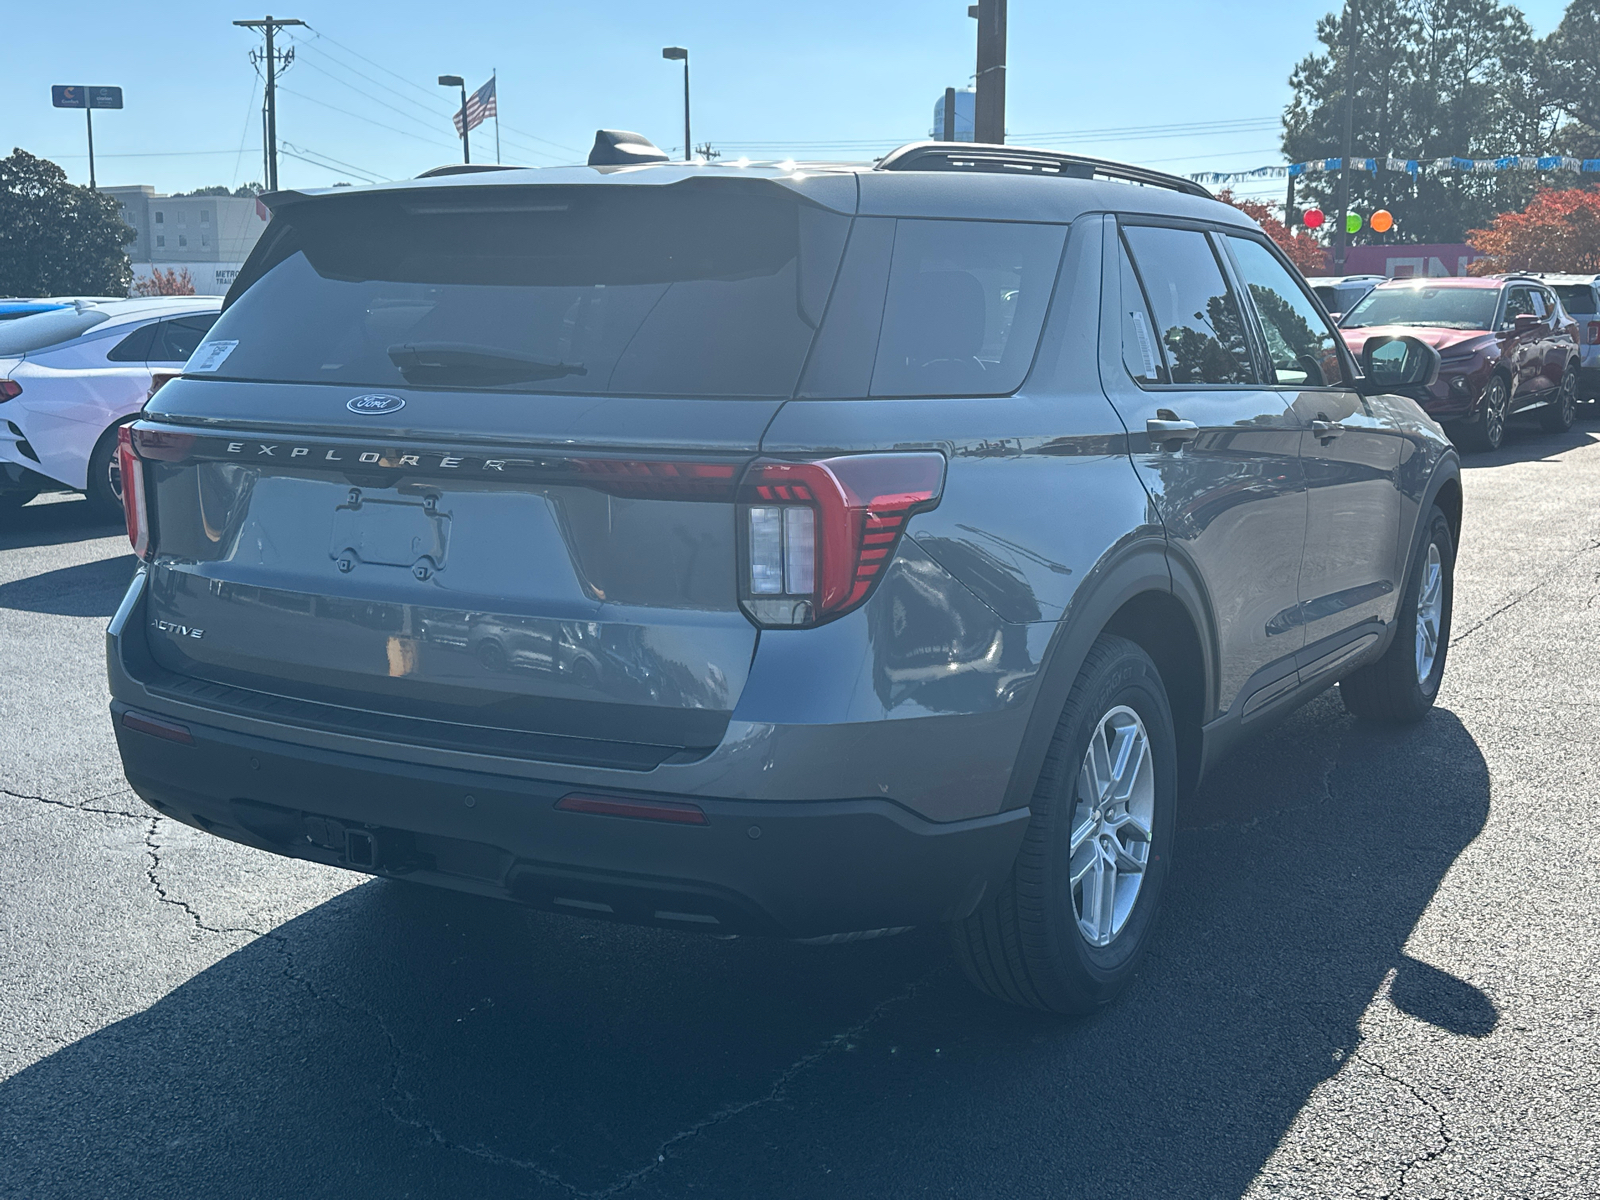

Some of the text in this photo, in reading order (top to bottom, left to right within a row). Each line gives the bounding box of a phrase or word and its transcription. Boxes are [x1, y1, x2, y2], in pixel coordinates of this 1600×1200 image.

[357, 395, 392, 408] Ford
[226, 442, 506, 471] EXPLORER
[151, 619, 205, 639] ACTIVE
